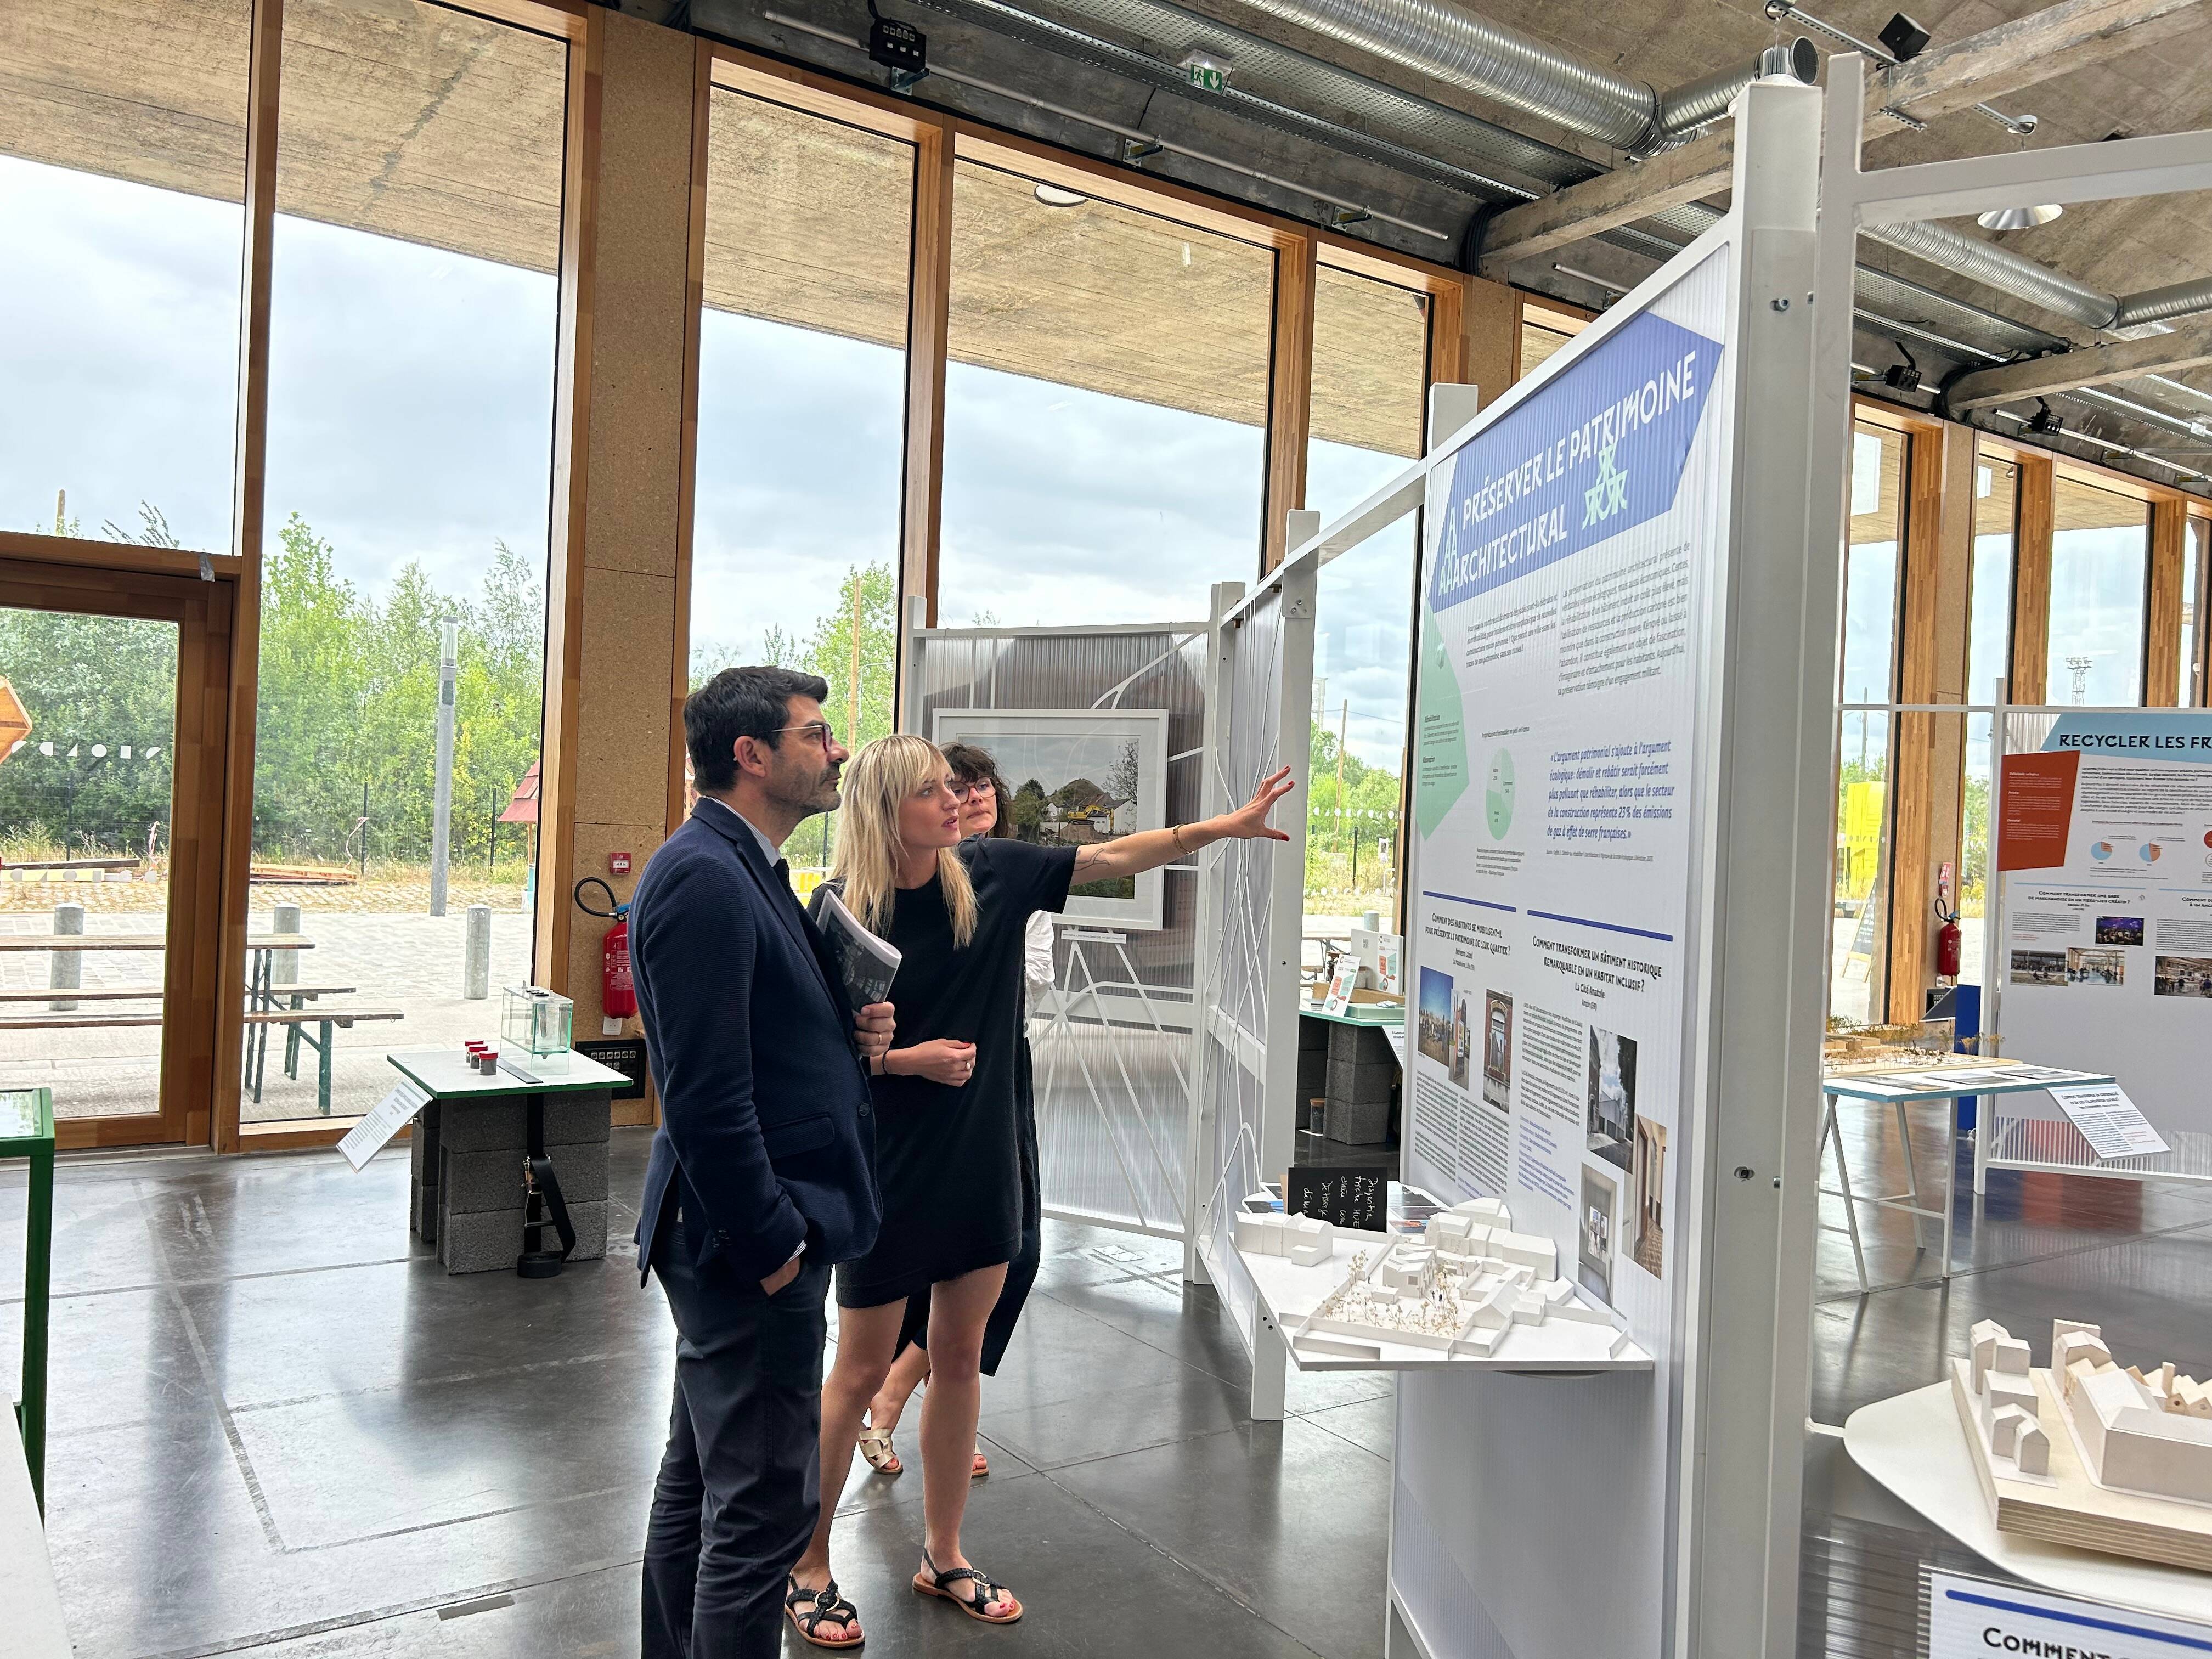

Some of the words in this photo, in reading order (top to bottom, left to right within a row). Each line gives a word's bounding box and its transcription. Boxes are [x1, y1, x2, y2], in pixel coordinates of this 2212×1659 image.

[1463, 452, 1542, 531] PRÉSERVER
[1546, 437, 1566, 483] LE
[1569, 351, 1696, 470] PATRIMOINE
[1580, 745, 1610, 763] patrimonial
[1611, 744, 1633, 760] s'ajoute
[1634, 742, 1637, 755] à
[1639, 740, 1671, 757] l'argument
[2059, 734, 2150, 748] RECYCLER
[2155, 736, 2185, 749] LES
[1576, 766, 1594, 779] démolir
[1595, 768, 1601, 778] et
[1602, 765, 1621, 778] rebâtir
[1621, 763, 1638, 777] serait
[1638, 761, 1669, 779] forcément
[1548, 787, 1558, 803] plus
[1559, 787, 1579, 803] polluant
[1580, 789, 1589, 802] que
[1618, 785, 1633, 798] alors
[1634, 787, 1644, 801] que
[1646, 783, 1651, 797] le
[1652, 785, 1675, 797] secteur
[1548, 806, 1554, 817] de
[1554, 806, 1559, 817] la
[1559, 806, 1589, 819] construction
[1590, 805, 1617, 821] représente
[1632, 805, 1642, 819] des
[1643, 805, 1672, 819] émissions
[1547, 825, 1553, 836] de
[1553, 827, 1561, 839] gaz
[1562, 825, 1566, 837] à
[1567, 825, 1578, 840] effet
[1578, 825, 1584, 837] de
[1585, 828, 1598, 838] serre
[1533, 935, 1555, 951] COMMENT
[1556, 943, 1591, 960] TRANSFORMER
[1592, 951, 1599, 961] UN
[1600, 950, 1626, 968] BÂTIMENT
[1627, 959, 1662, 980] HISTORIQUE
[1544, 957, 1577, 974] REMARQUABLE
[1578, 965, 1584, 975] EN
[1585, 967, 1593, 978] UN
[1594, 969, 1615, 984] HABITAT
[1615, 975, 1640, 992] INCLUSIF
[1641, 979, 1645, 992] ?
